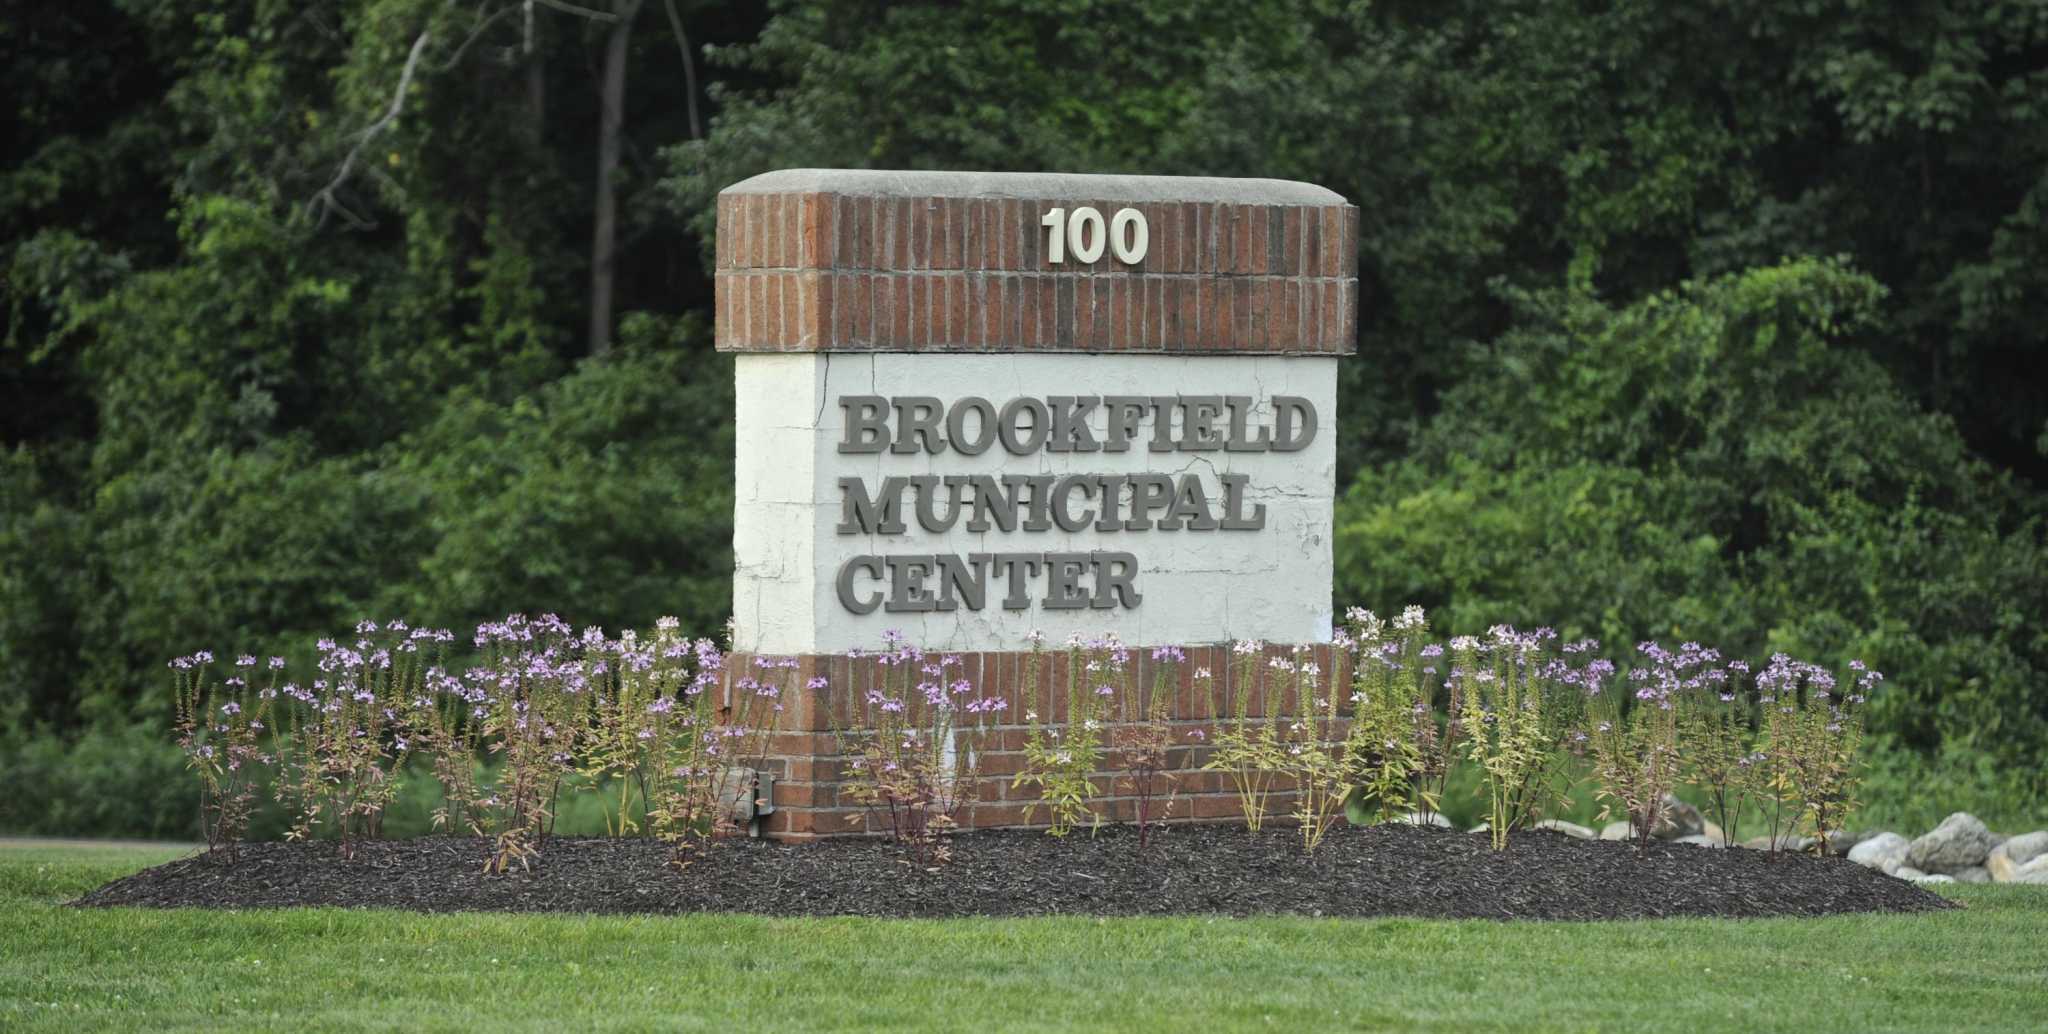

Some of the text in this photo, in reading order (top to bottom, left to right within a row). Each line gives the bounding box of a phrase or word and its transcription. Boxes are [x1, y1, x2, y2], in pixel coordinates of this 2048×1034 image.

[1042, 207, 1149, 265] 100
[838, 395, 1318, 456] BROOKFIELD
[837, 473, 1266, 535] MUNICIPAL
[836, 551, 1143, 615] CENTER
